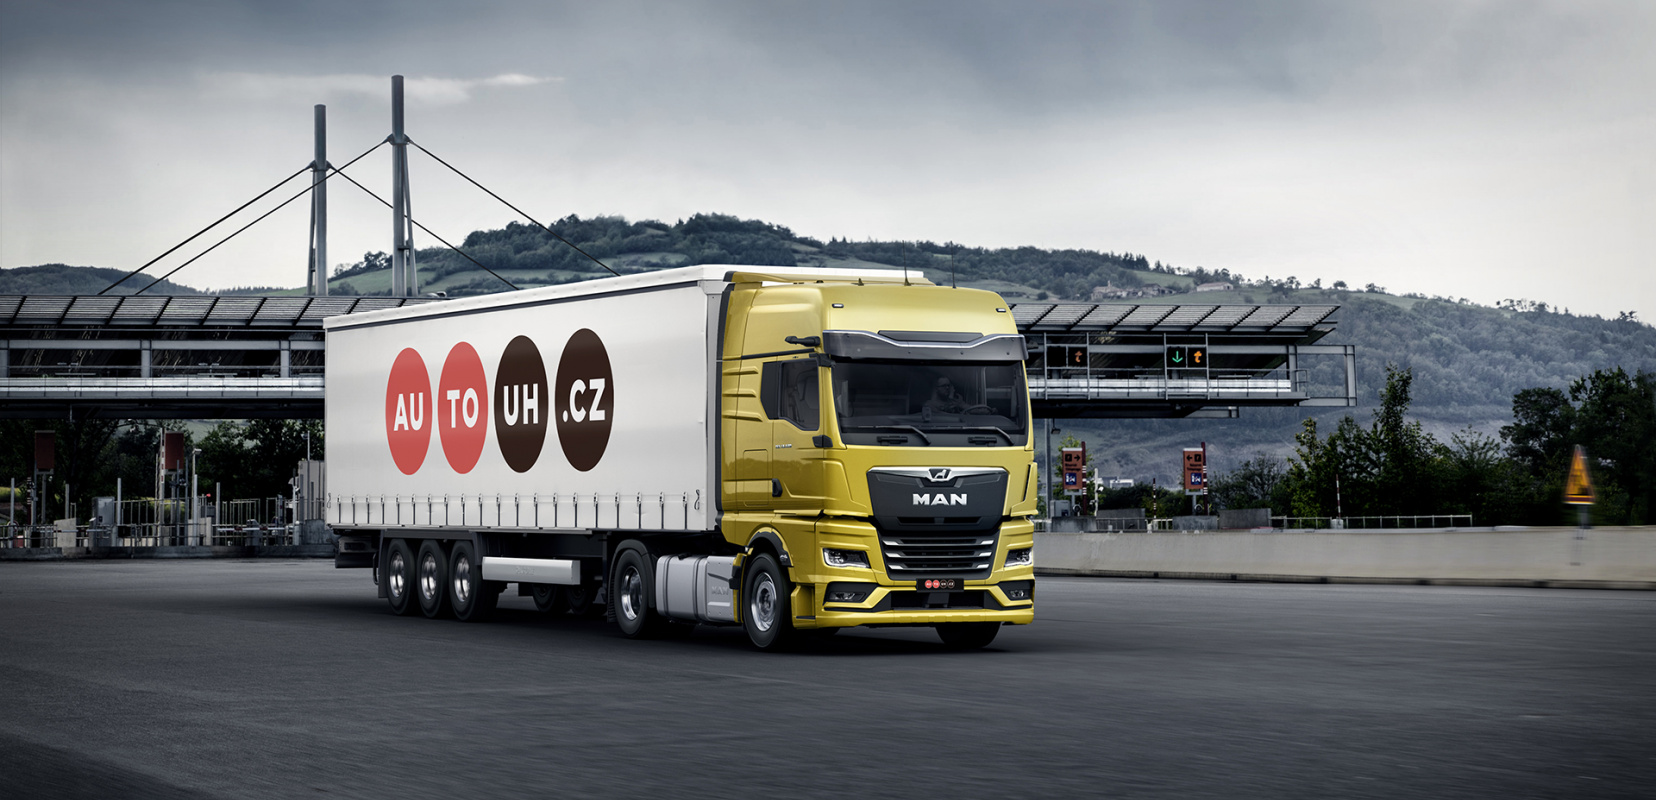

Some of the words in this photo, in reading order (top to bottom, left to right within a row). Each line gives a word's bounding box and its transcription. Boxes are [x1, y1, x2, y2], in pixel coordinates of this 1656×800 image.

[393, 392, 424, 431] AU
[447, 387, 479, 428] TO
[503, 383, 539, 426] UH
[562, 378, 606, 423] .CZ
[912, 493, 968, 506] MAN
